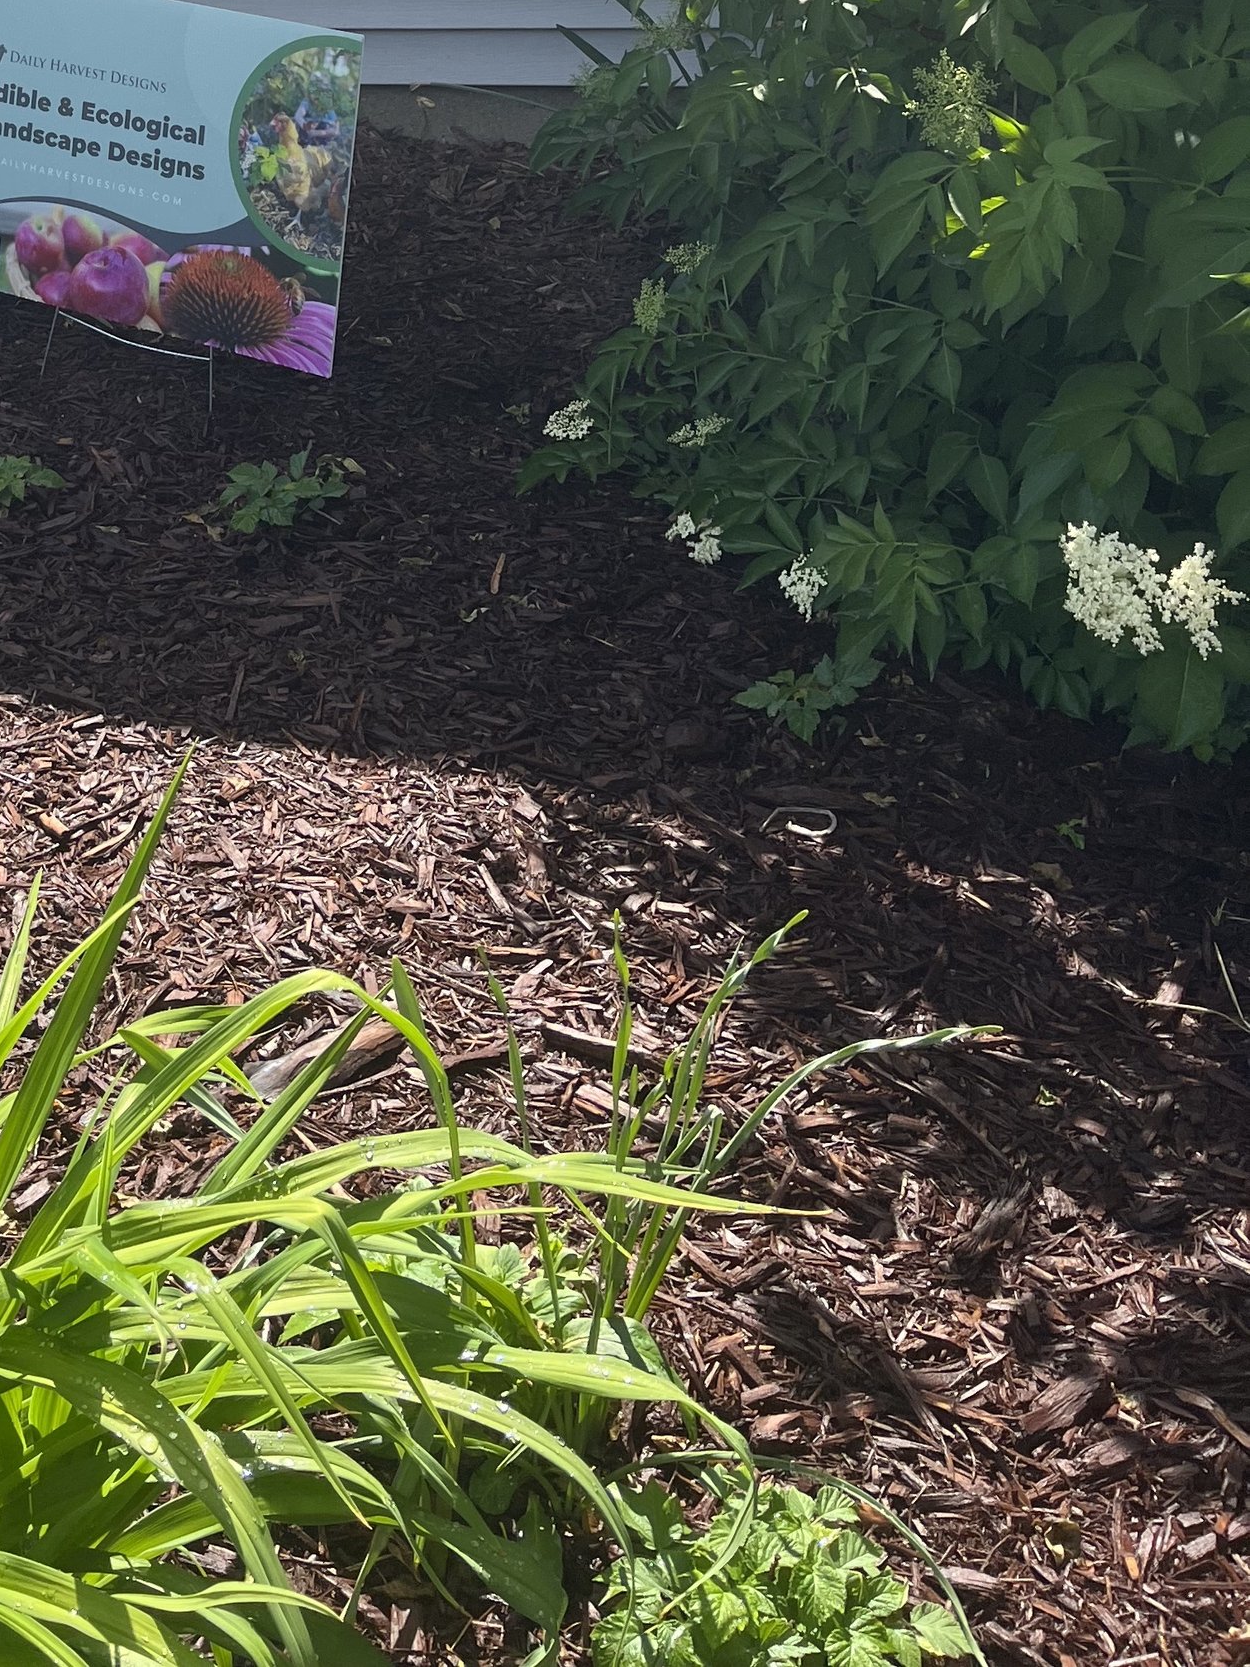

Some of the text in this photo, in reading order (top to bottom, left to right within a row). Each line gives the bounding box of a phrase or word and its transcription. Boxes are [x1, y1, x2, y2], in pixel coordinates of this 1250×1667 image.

[9, 50, 167, 94] DAILY HARVEST DESIGNS
[57, 97, 74, 117] &
[81, 100, 206, 146] Ecological
[108, 141, 205, 180] Designs
